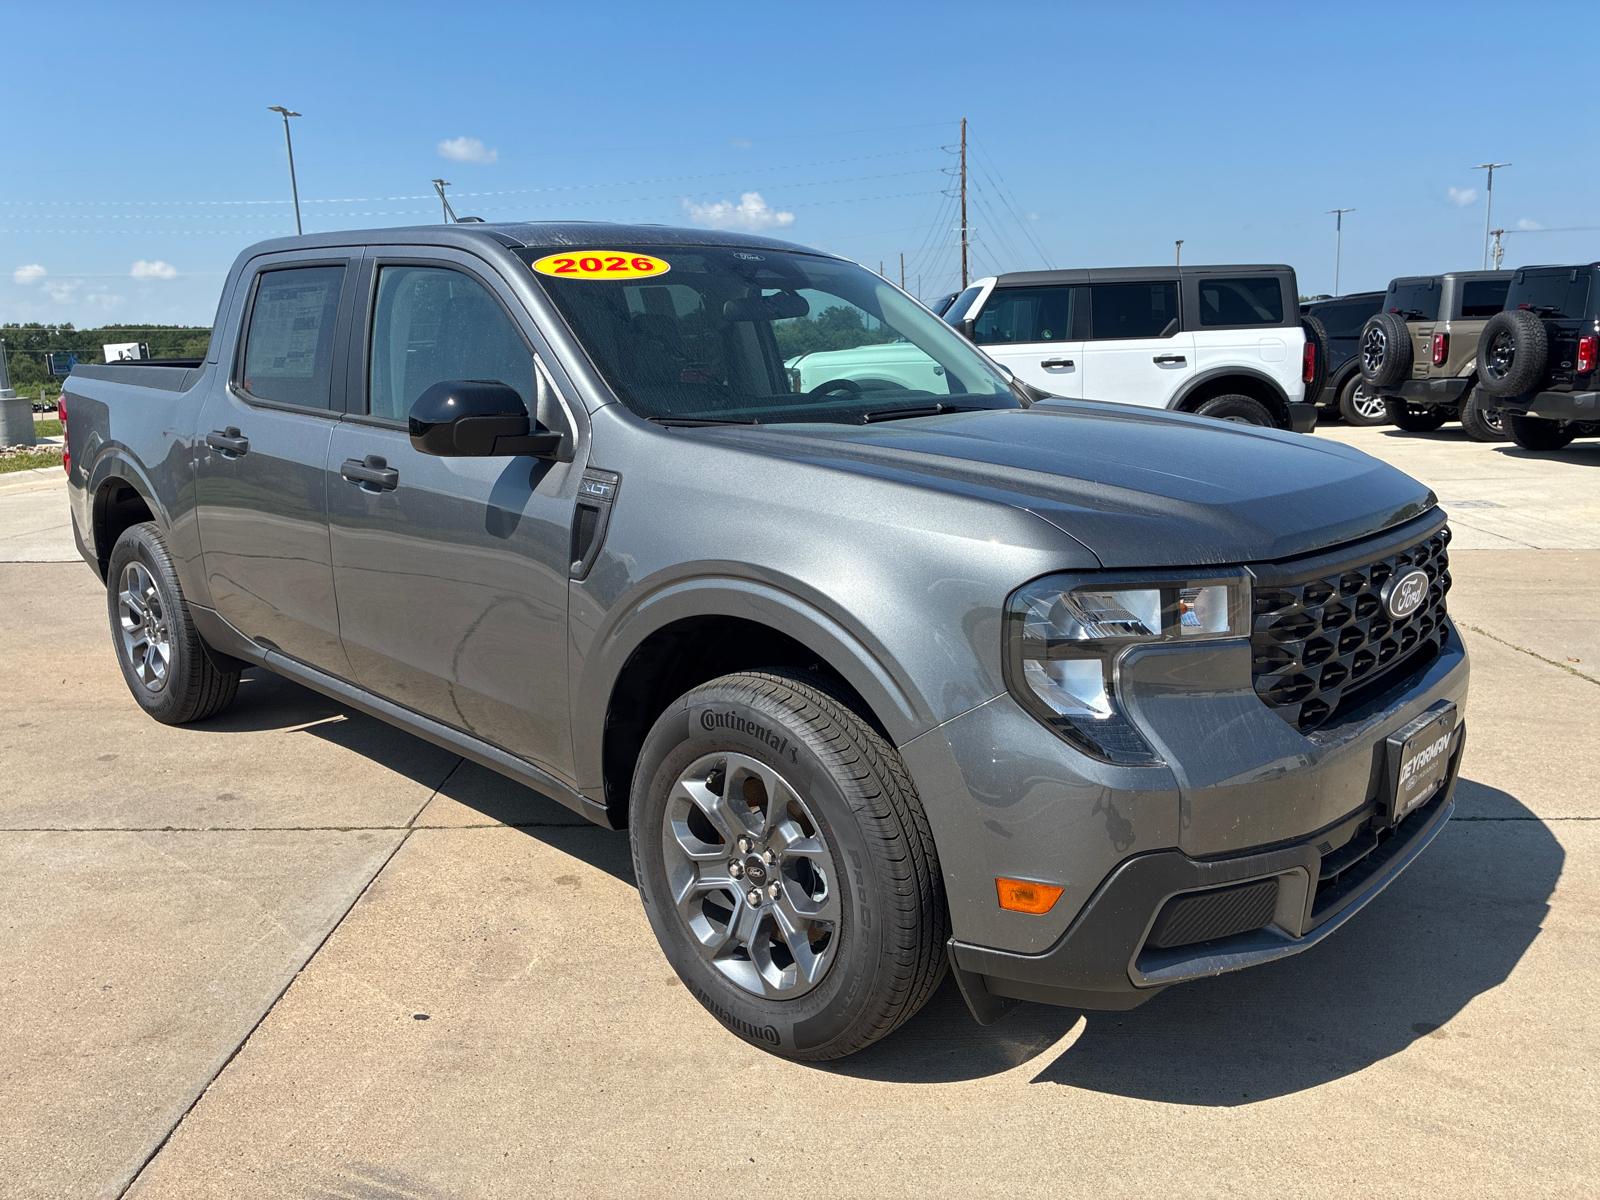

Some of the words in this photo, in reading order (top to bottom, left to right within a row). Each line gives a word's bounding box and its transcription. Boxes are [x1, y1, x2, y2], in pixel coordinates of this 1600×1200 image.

[552, 256, 655, 274] 2026
[581, 481, 610, 494] XLT
[1397, 578, 1423, 611] Ford
[700, 708, 788, 754] Continental
[697, 988, 781, 1046] Continental
